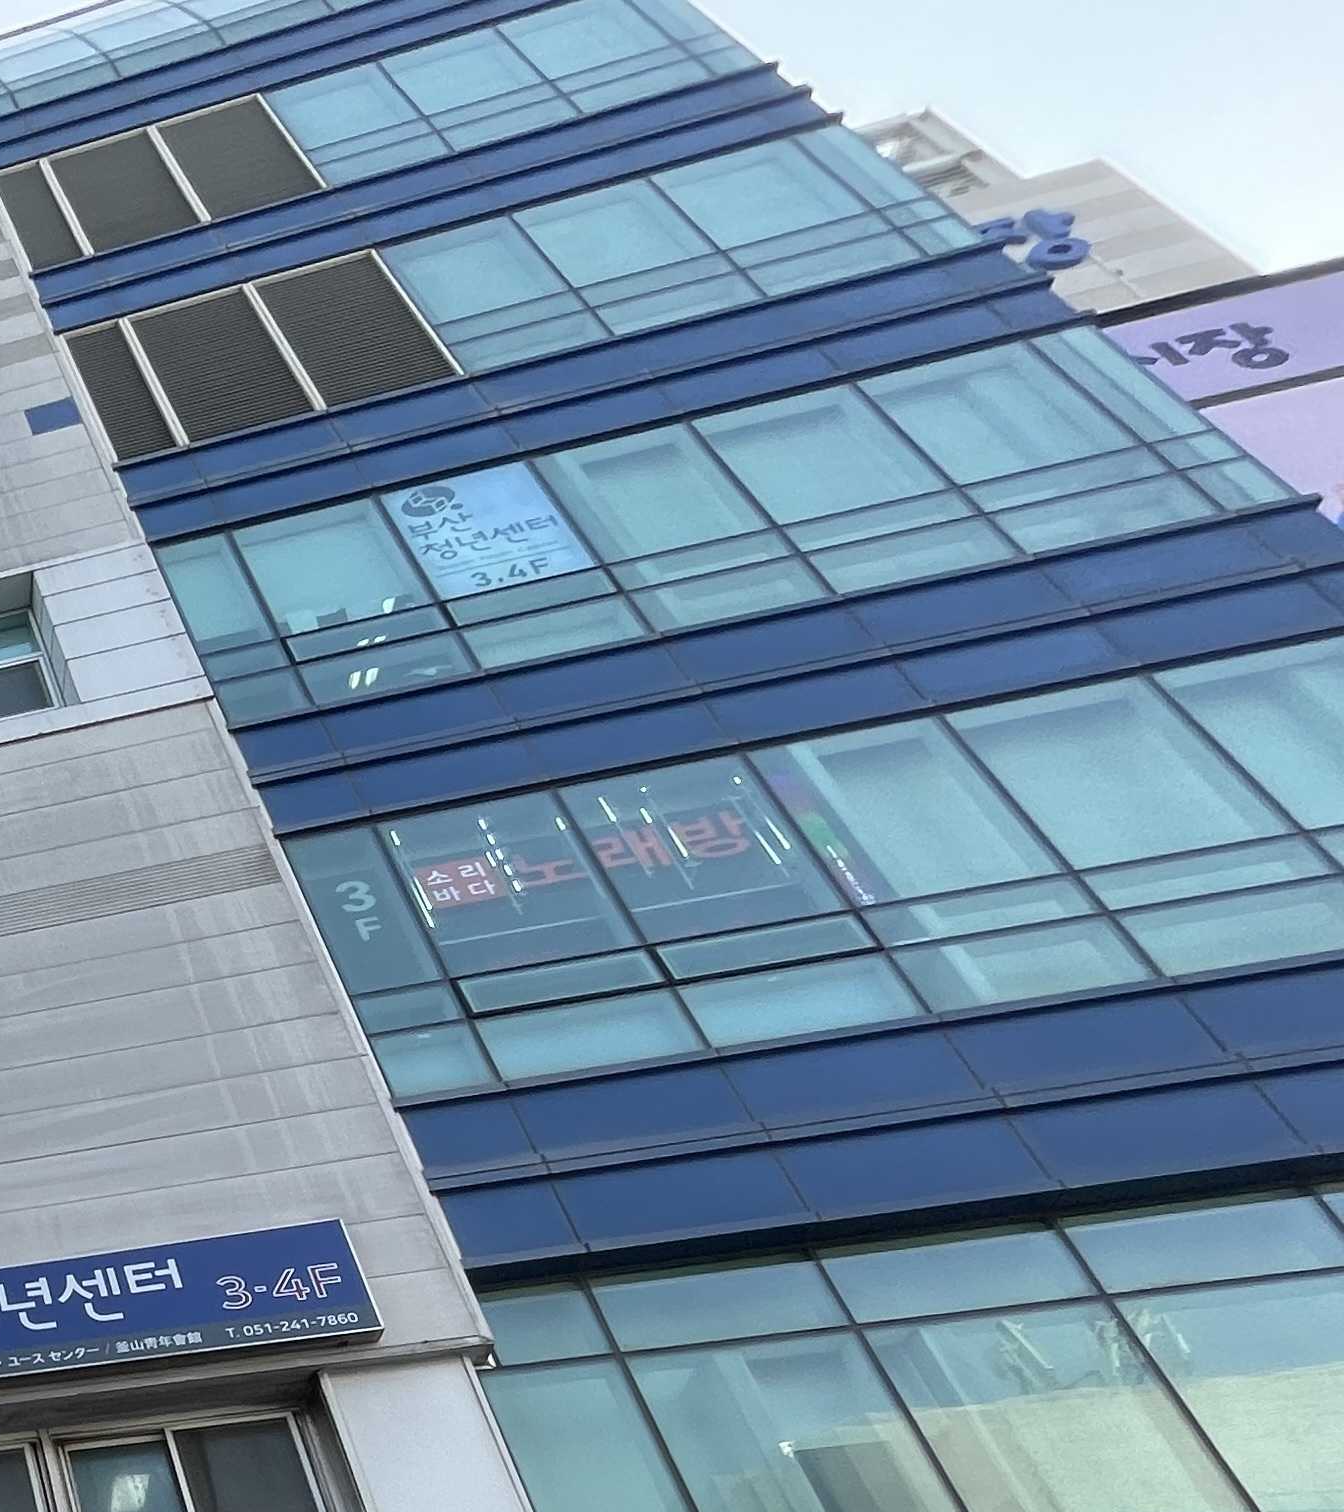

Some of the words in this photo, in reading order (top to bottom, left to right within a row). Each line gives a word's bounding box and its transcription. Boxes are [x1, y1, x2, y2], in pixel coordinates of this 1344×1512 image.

[408, 512, 473, 541] 부산
[420, 514, 559, 560] 청년센터
[514, 804, 755, 888] 노래방
[426, 861, 488, 886] 소리
[433, 879, 498, 903] 바다
[243, 1312, 360, 1338] 051-241-7860
[48, 1345, 100, 1363] センター
